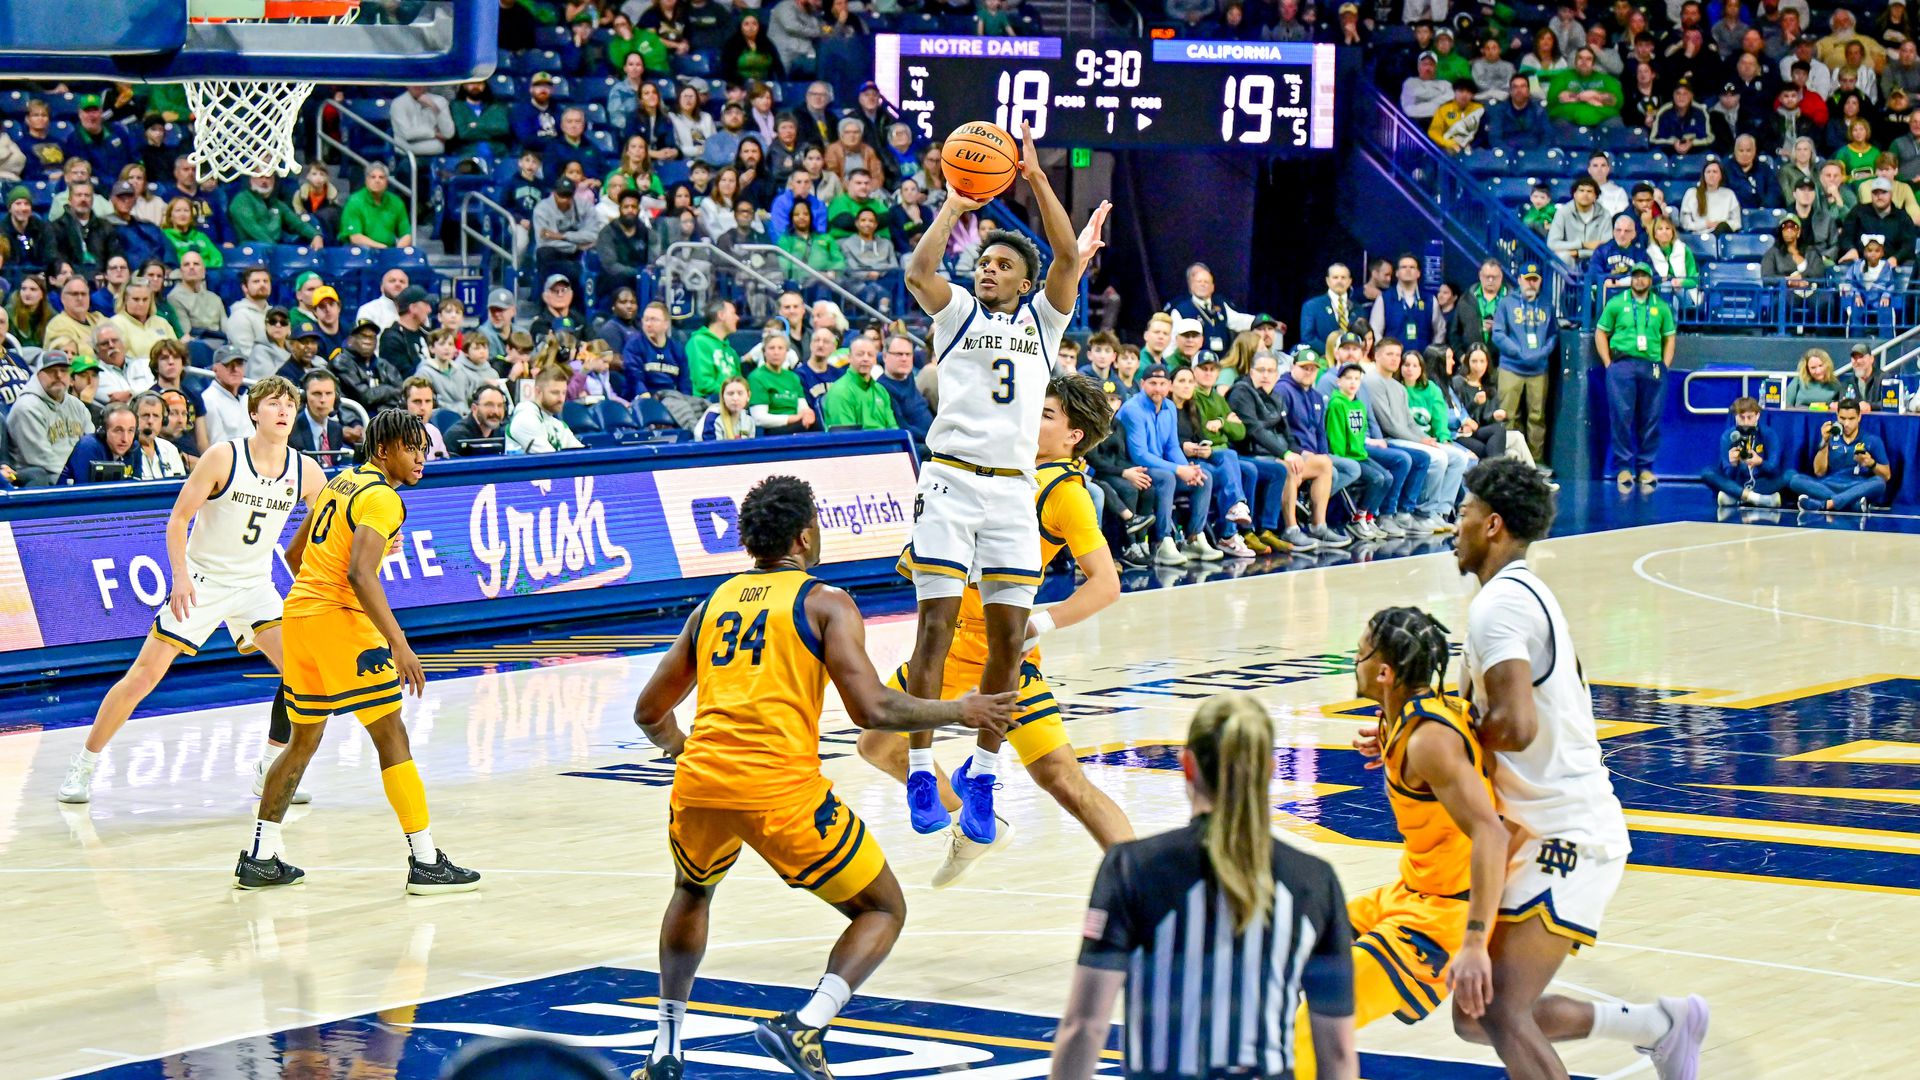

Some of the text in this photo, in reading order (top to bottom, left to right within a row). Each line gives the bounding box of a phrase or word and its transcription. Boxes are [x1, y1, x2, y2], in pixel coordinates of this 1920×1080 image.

[920, 38, 1040, 56] NOTRE DAME
[1186, 44, 1282, 60] CALIFORNIA
[1075, 49, 1142, 87] 9:30
[911, 78, 923, 98] 4
[1289, 84, 1301, 105] 3
[995, 69, 1050, 140] 18
[1221, 74, 1275, 144] 19
[917, 111, 933, 139] 5
[1106, 111, 1115, 134] 1
[1292, 118, 1308, 146] 5
[957, 126, 1004, 146] Wilson
[463, 287, 476, 305] 11
[962, 335, 1039, 356] NOTRE DAME
[991, 358, 1016, 404] 3
[231, 490, 293, 512] NOTRE DAME
[242, 510, 267, 546] 5
[311, 498, 337, 544] 0
[739, 585, 771, 603] DORT
[711, 609, 770, 667] 34
